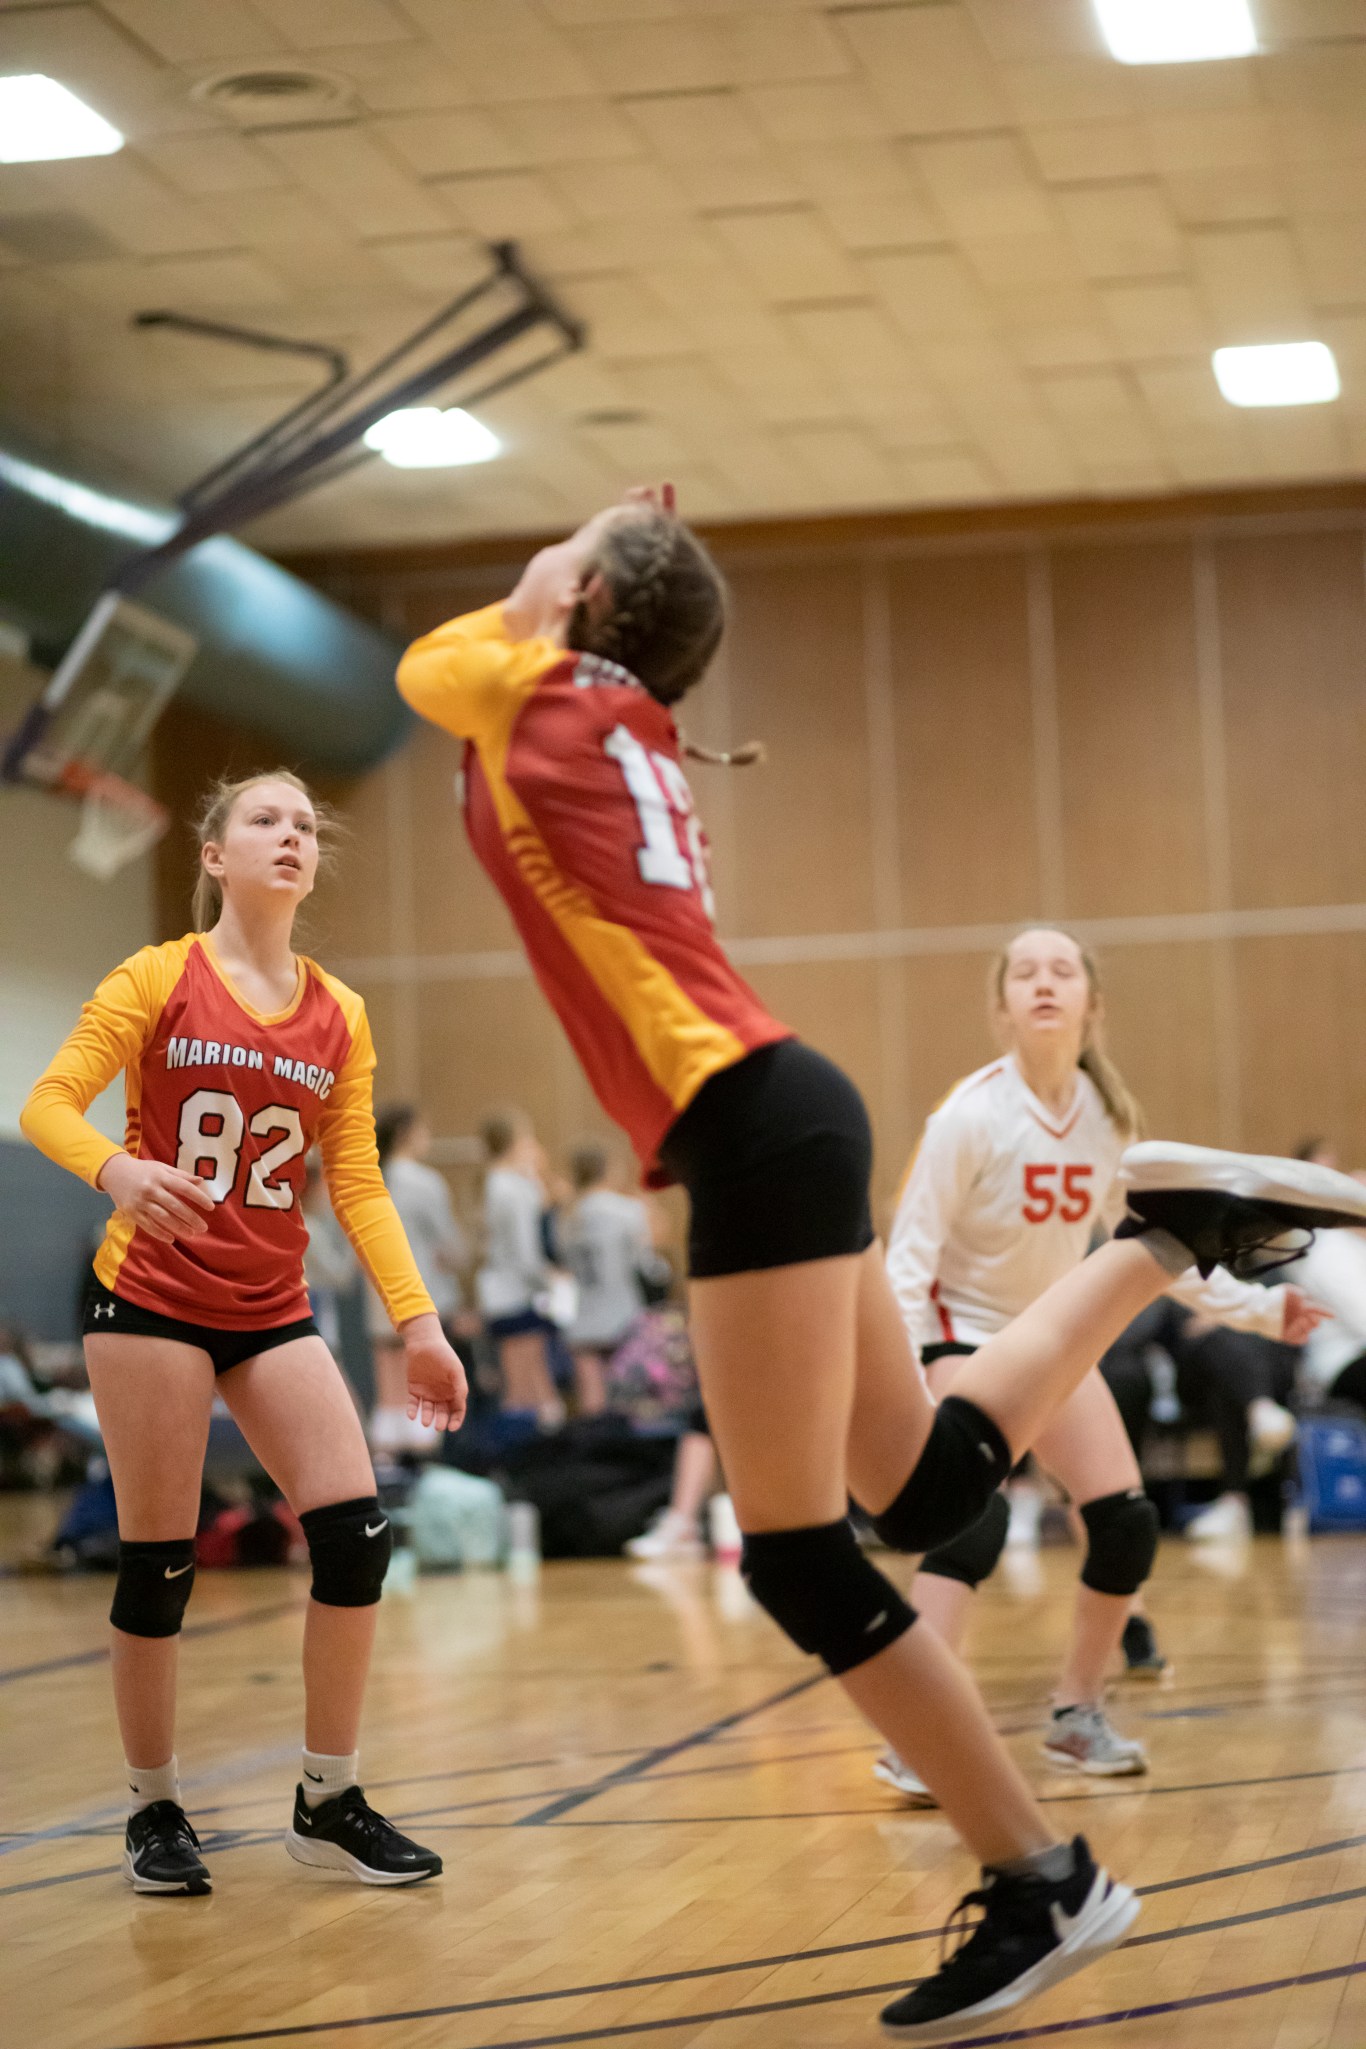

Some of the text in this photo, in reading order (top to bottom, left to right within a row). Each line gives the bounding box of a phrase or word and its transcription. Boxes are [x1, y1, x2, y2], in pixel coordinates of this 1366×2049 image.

[166, 1036, 335, 1101] MARION MAGIC
[175, 1087, 304, 1211] 82
[1022, 1163, 1093, 1224] 55
